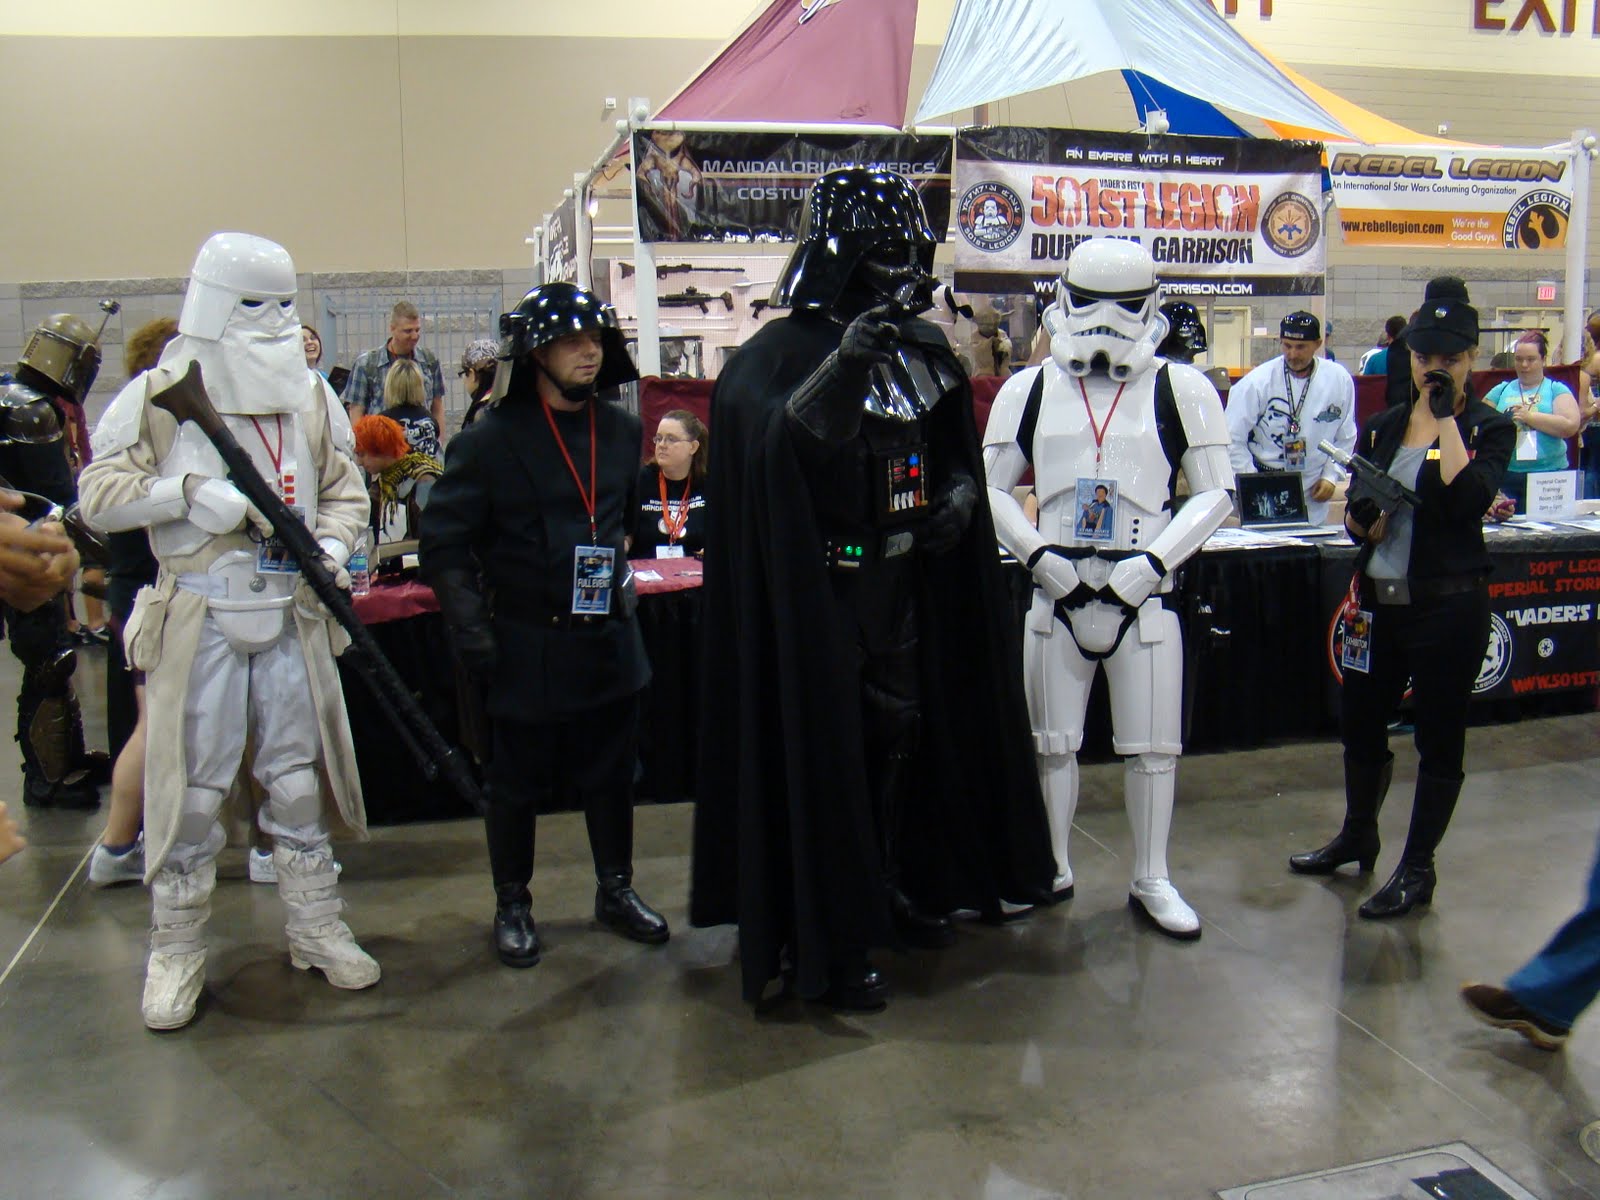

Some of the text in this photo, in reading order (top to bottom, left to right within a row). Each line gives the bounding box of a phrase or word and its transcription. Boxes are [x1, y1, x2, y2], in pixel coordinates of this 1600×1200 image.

[1474, 0, 1600, 34] EXI
[1065, 148, 1225, 166] AN EMPIRE WITH A HEART
[1331, 153, 1567, 183] REBEL LEGION
[1099, 178, 1141, 190] VADER'S FIST
[1343, 181, 1391, 191] International
[1393, 182, 1408, 191] Star
[1411, 182, 1430, 192] Wars
[1432, 183, 1470, 196] Costuming
[1471, 184, 1517, 196] Organization
[1031, 174, 1139, 229] 501ST
[1141, 181, 1260, 233] LEGION
[1452, 217, 1489, 229] We're the
[1505, 193, 1569, 242] REBEL LEGION
[988, 228, 1017, 250] LEGION
[1451, 231, 1498, 244] Good Guys.
[1031, 233, 1254, 264] DUN GARRISON
[1345, 635, 1368, 649] EXHIBITOR
